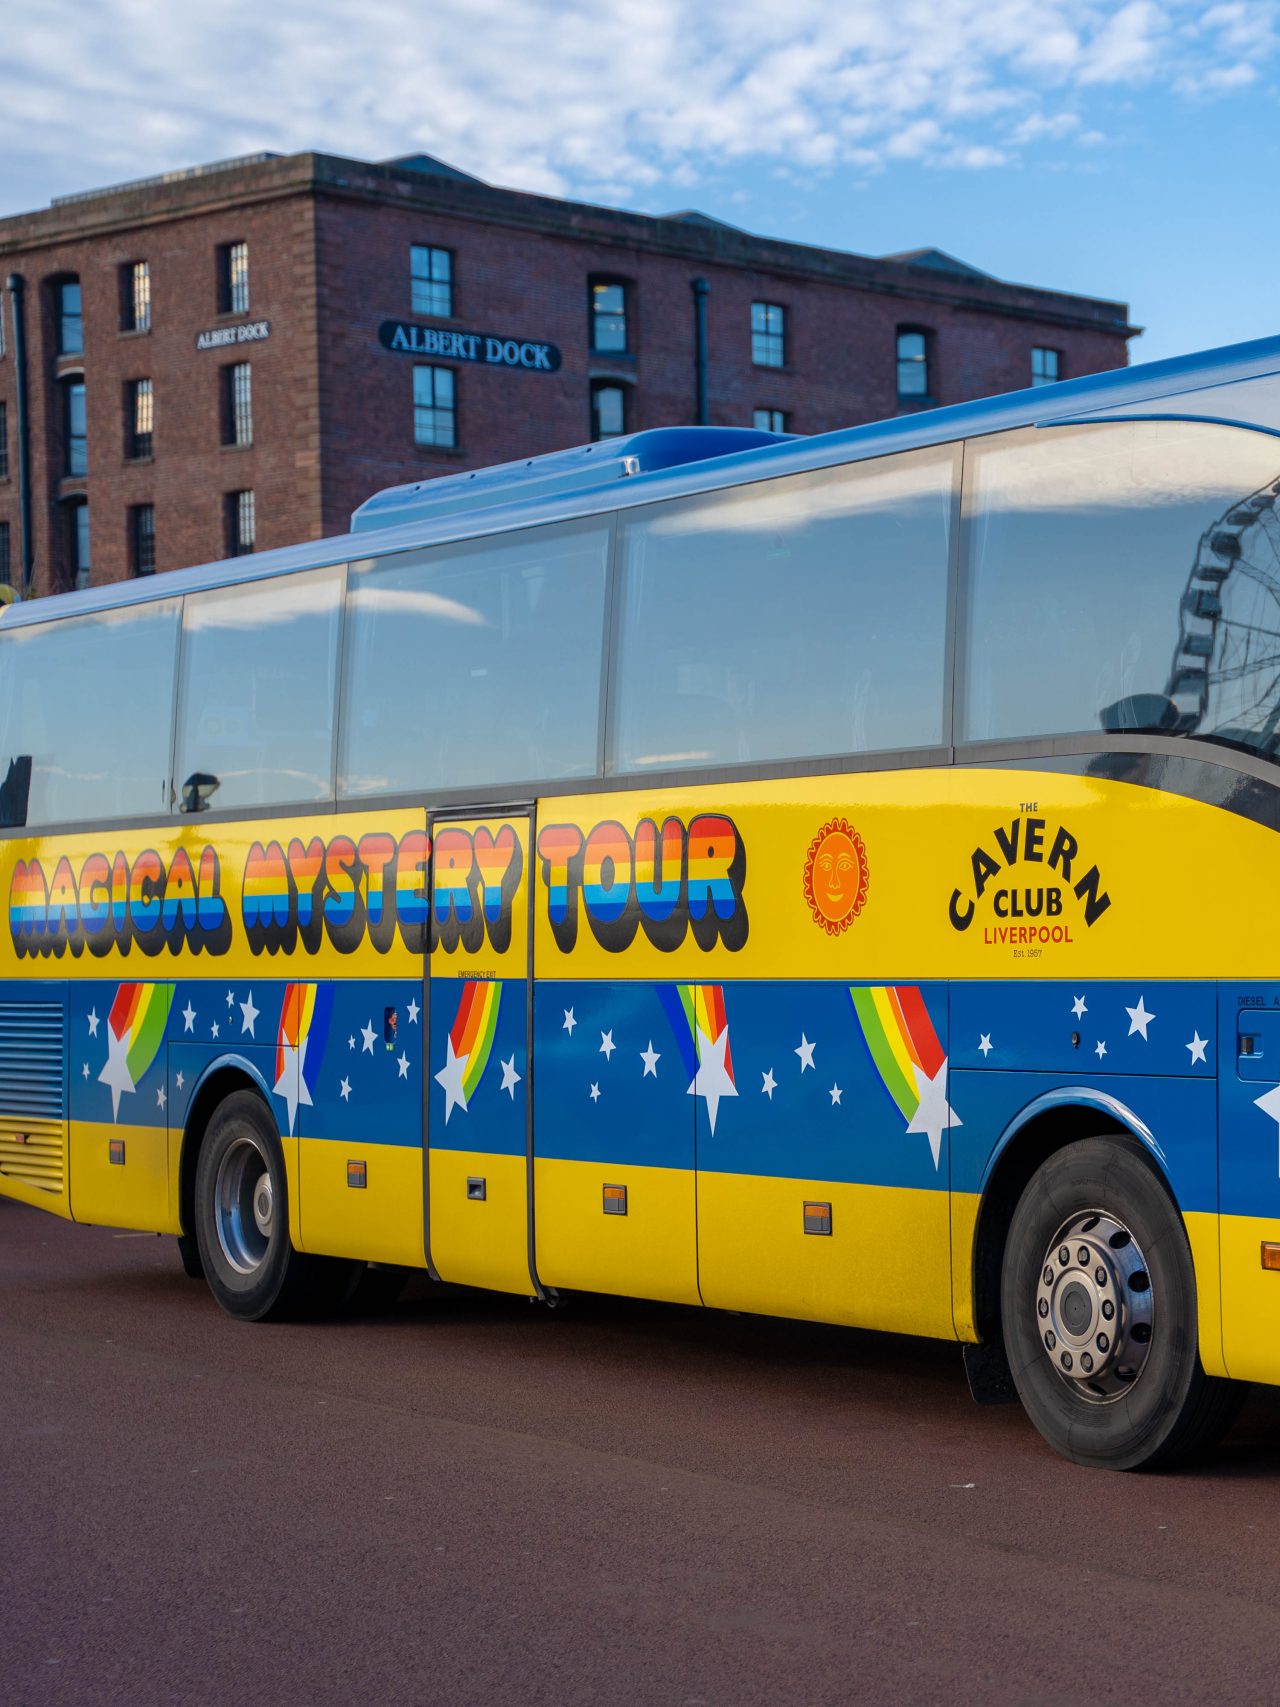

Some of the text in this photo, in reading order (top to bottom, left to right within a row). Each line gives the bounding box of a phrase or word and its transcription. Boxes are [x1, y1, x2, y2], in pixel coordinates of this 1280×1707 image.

[197, 322, 269, 349] ALBERT DOCK
[391, 325, 550, 369] ALBERT DOCK
[1020, 802, 1038, 813] THE
[9, 813, 749, 960] MAGICAL MYSTERY TOUR
[948, 817, 1112, 932] CAVERN
[993, 887, 1063, 918] CLUB
[984, 925, 1074, 945] LIVERPOOL
[457, 970, 496, 978] EMERGENCY EXIT
[1237, 996, 1266, 1007] DIESEL
